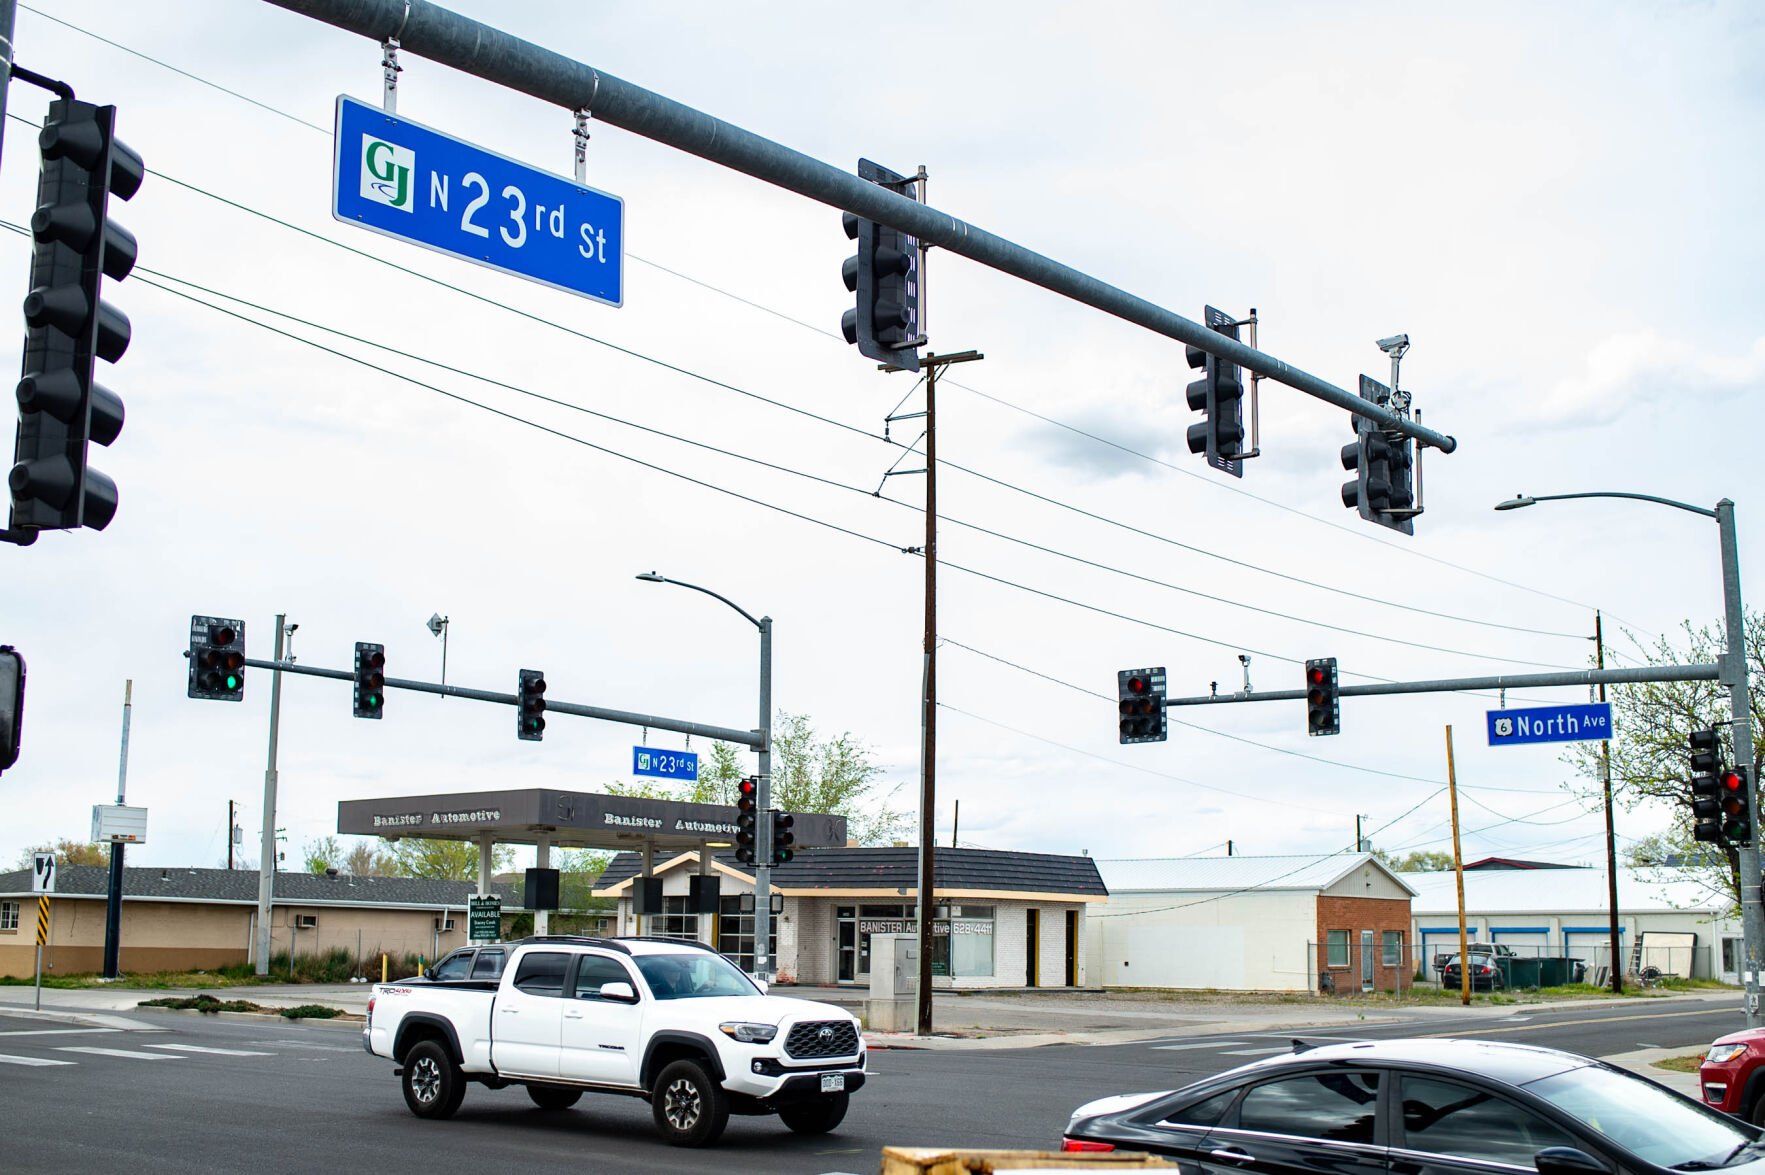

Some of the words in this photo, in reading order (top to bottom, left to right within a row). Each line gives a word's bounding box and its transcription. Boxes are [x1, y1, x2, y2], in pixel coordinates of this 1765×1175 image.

[430, 170, 449, 212] N
[460, 171, 565, 249] 23rd
[579, 223, 606, 264] St
[1500, 722, 1507, 733] 6
[1517, 713, 1578, 737] North
[1583, 715, 1606, 728] Ave
[653, 757, 658, 768] N
[660, 755, 684, 773] 23rd
[686, 761, 694, 772] St
[373, 814, 423, 827] Banister
[431, 810, 501, 824] Automotive
[604, 812, 663, 828] Banister
[675, 819, 741, 834] Automotiv
[470, 910, 501, 918] AVAILABLE
[860, 921, 902, 933] BANISTER
